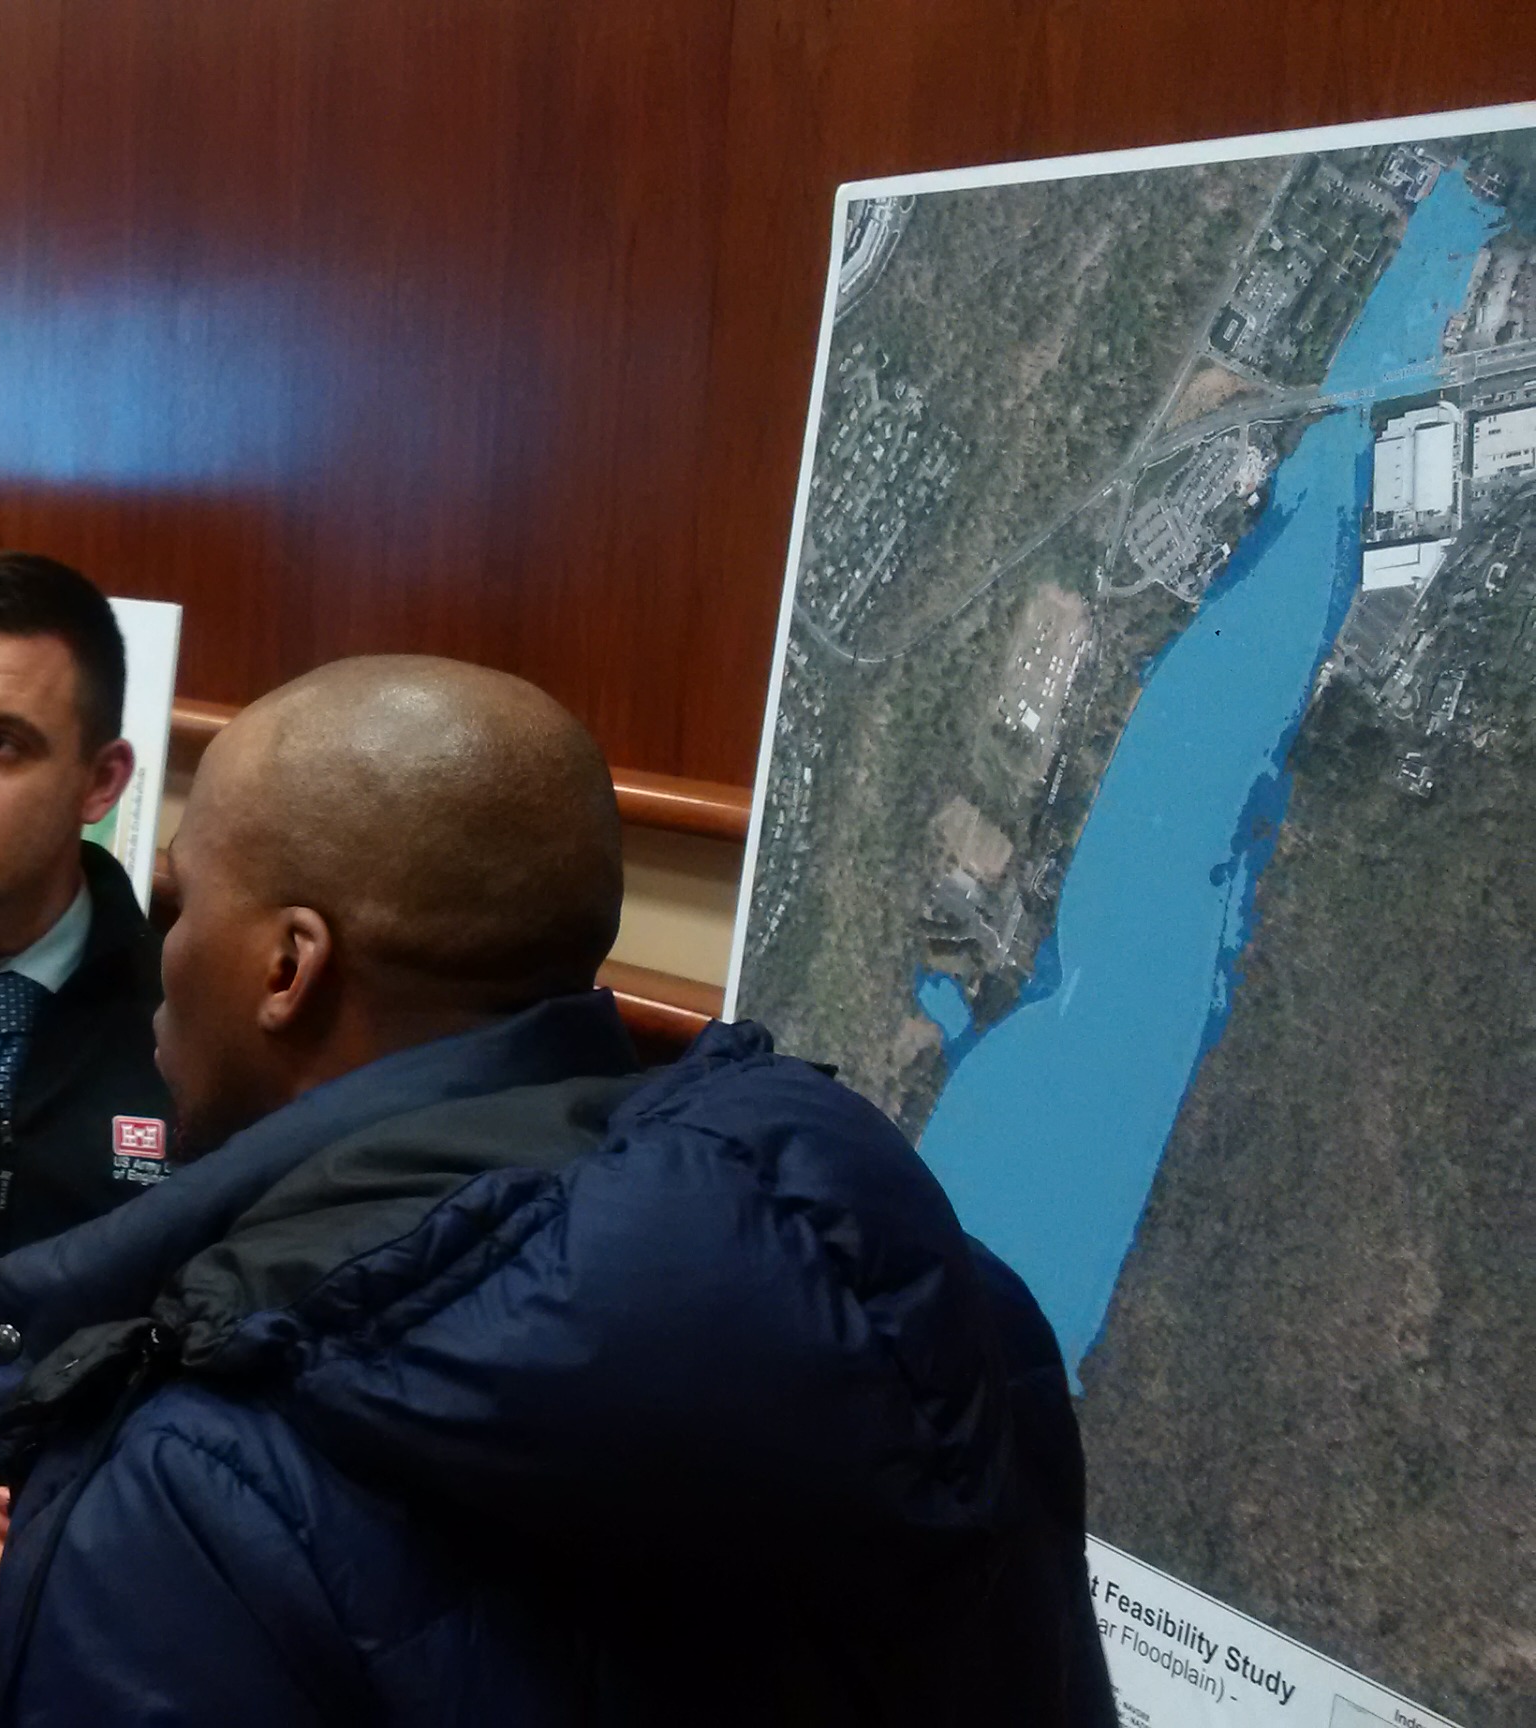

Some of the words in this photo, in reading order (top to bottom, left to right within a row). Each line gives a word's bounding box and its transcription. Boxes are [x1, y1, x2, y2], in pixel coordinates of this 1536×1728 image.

[112, 1168, 126, 1180] of
[114, 1156, 130, 1168] US
[133, 1159, 162, 1175] Army
[1096, 1618, 1118, 1639] ar
[1120, 1625, 1225, 1704] Floodplain)
[1104, 1580, 1219, 1664] Feasibility
[1224, 1645, 1296, 1706] Study
